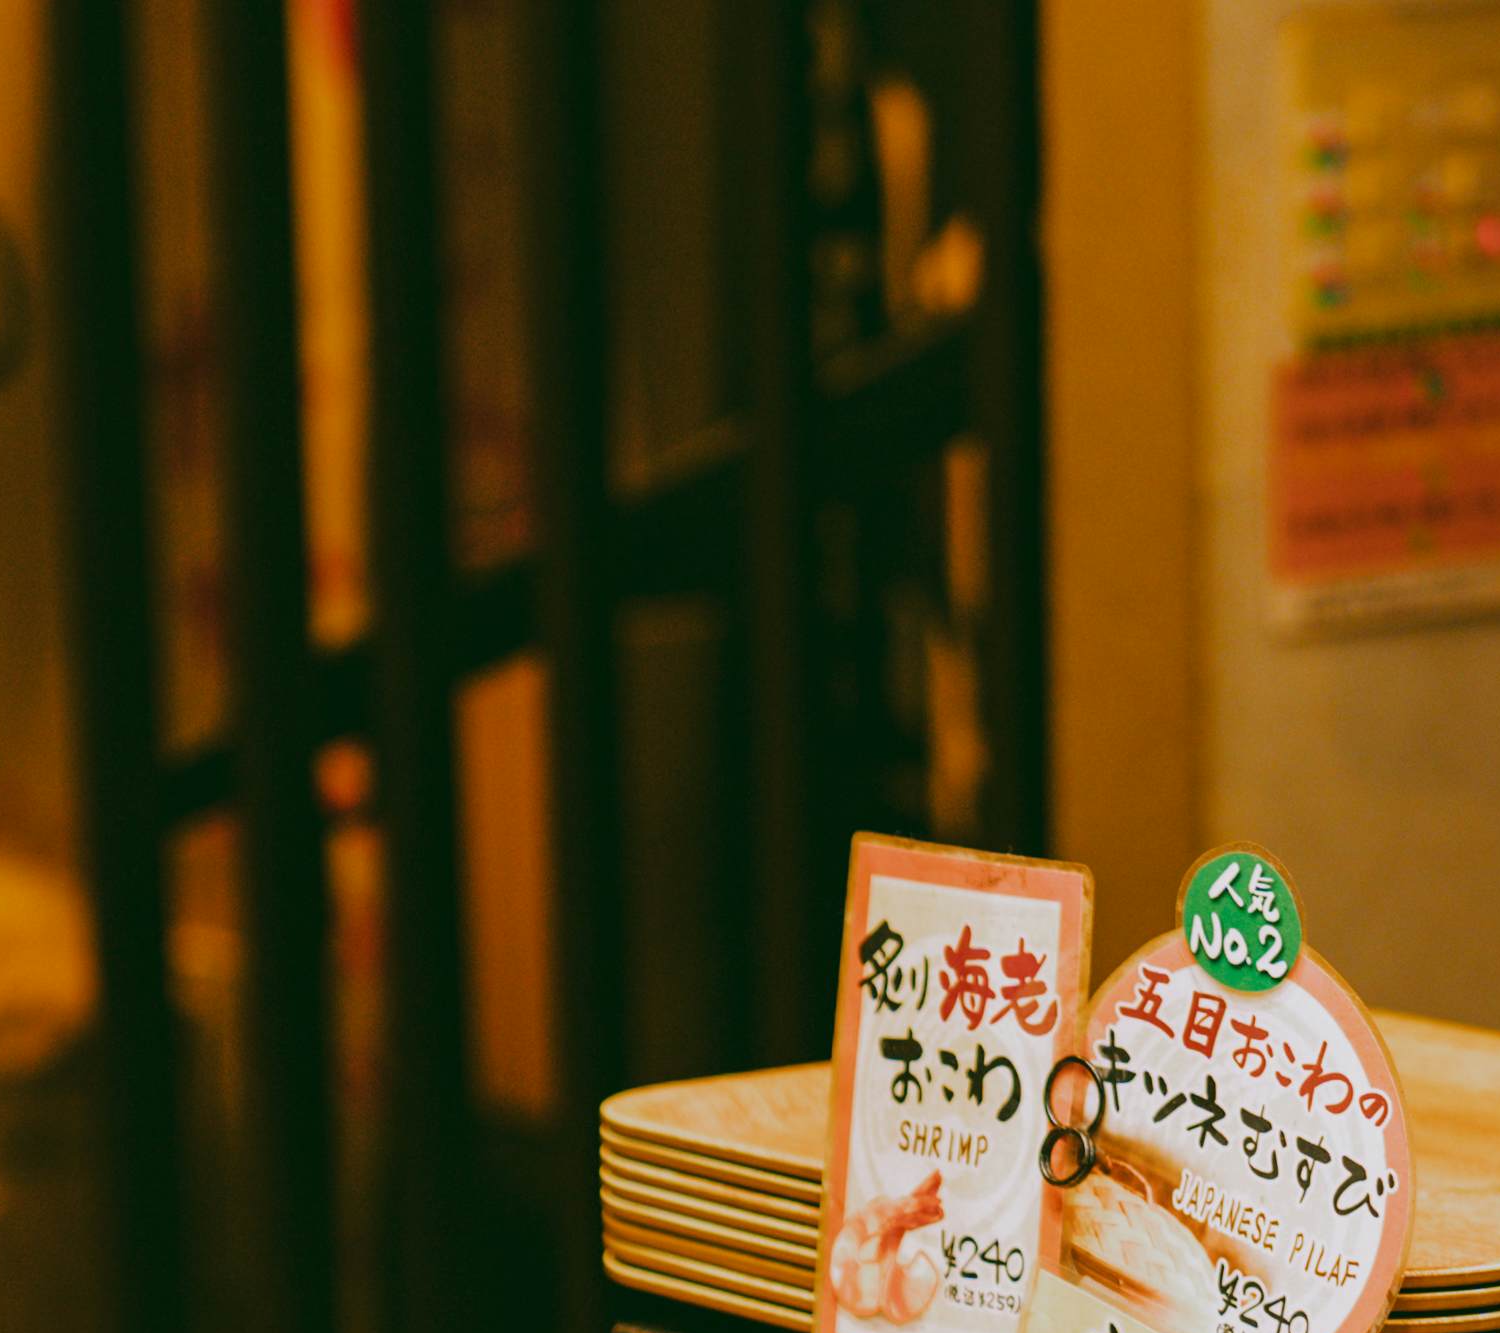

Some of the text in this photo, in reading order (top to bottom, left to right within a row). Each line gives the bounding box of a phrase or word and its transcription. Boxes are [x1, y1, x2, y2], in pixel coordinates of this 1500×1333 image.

[1205, 860, 1284, 923] 人気
[857, 919, 1061, 1037] 炙り海老
[1189, 911, 1290, 980] No.2
[879, 1027, 1022, 1122] おこわ
[1119, 965, 1394, 1130] 五目おこわの
[898, 1120, 990, 1169] SHRIMP
[1092, 1028, 1399, 1221] キツネむすび
[940, 1229, 1025, 1283] ¥240
[1171, 1168, 1362, 1290] JAPANESE PILAF
